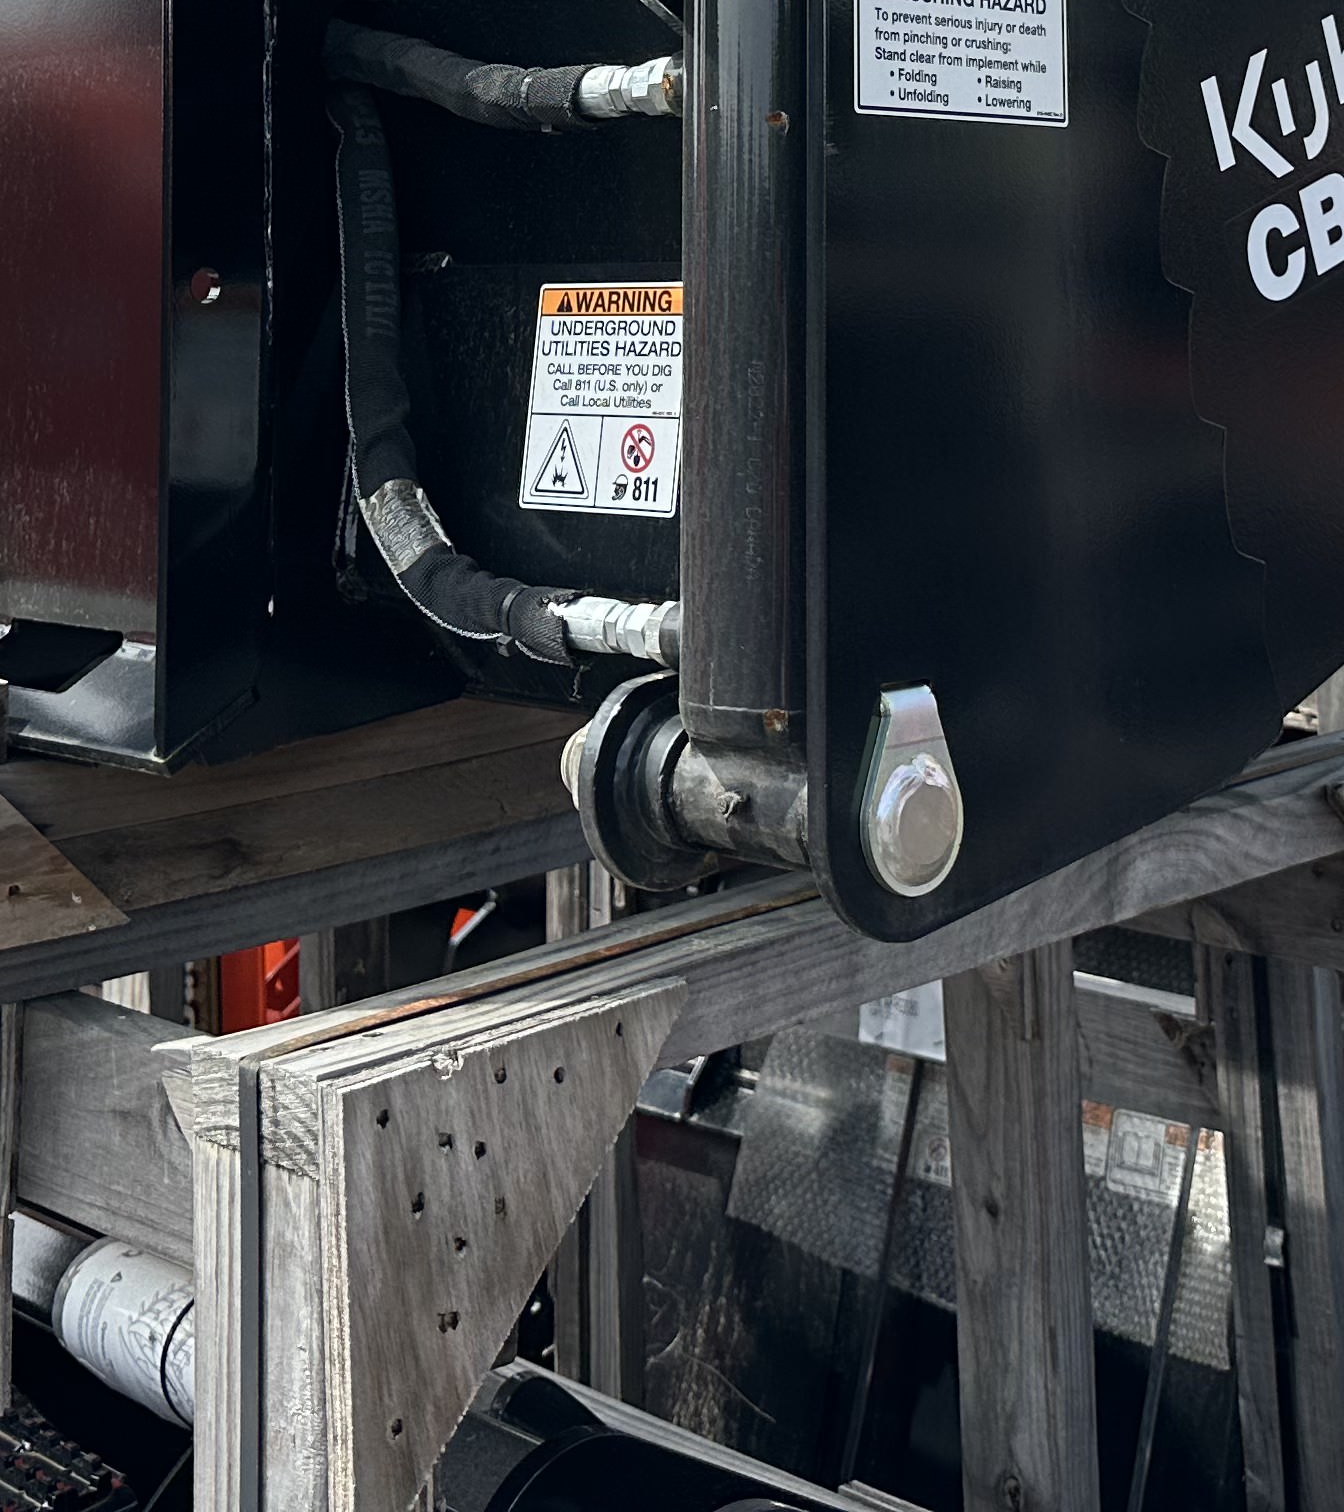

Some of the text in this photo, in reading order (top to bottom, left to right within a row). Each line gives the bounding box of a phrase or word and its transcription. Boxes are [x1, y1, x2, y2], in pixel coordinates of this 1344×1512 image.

[875, 8, 1046, 37] To prevent serious injury or death
[875, 28, 1012, 53] from pinching or crushing:
[875, 47, 1047, 73] Stand clear from implement while
[898, 68, 937, 86] Folding
[985, 75, 1022, 92] Raising
[898, 89, 949, 106] Unfolding
[985, 95, 1031, 112] Lowering
[576, 291, 672, 313] WARNING
[551, 320, 676, 336] UNDERGROUND
[542, 341, 682, 356] UTILITIES HAZARD
[547, 363, 672, 376] CALL BEFORE YOU DIG
[553, 380, 663, 394] Call 811 (U.S. only) or
[560, 395, 651, 408] Call Local Utilities
[632, 477, 659, 502] 811
